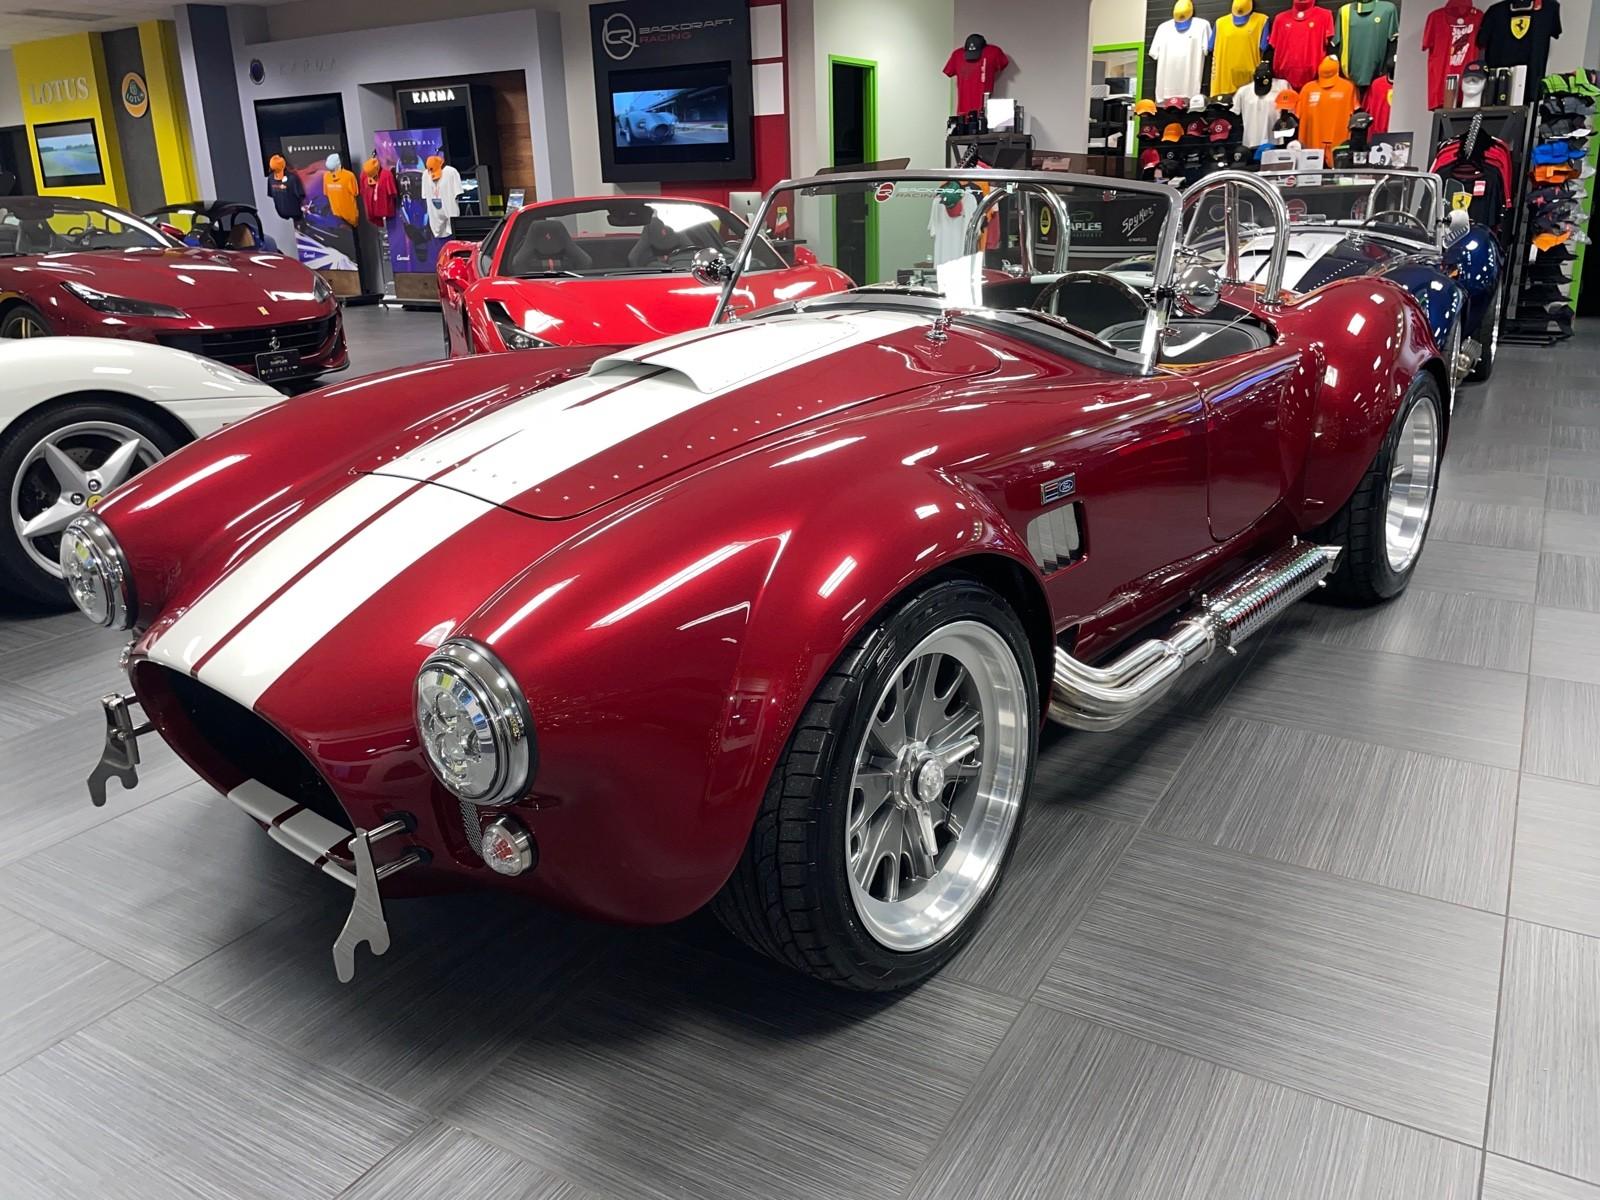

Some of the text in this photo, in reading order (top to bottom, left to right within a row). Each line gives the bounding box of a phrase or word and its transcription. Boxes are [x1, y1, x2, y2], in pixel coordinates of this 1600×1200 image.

[639, 18, 734, 34] BACKDRAFT
[640, 31, 690, 43] RACING
[31, 77, 88, 105] LOTUS
[412, 89, 455, 103] KARMA
[1069, 222, 1103, 231] APLES
